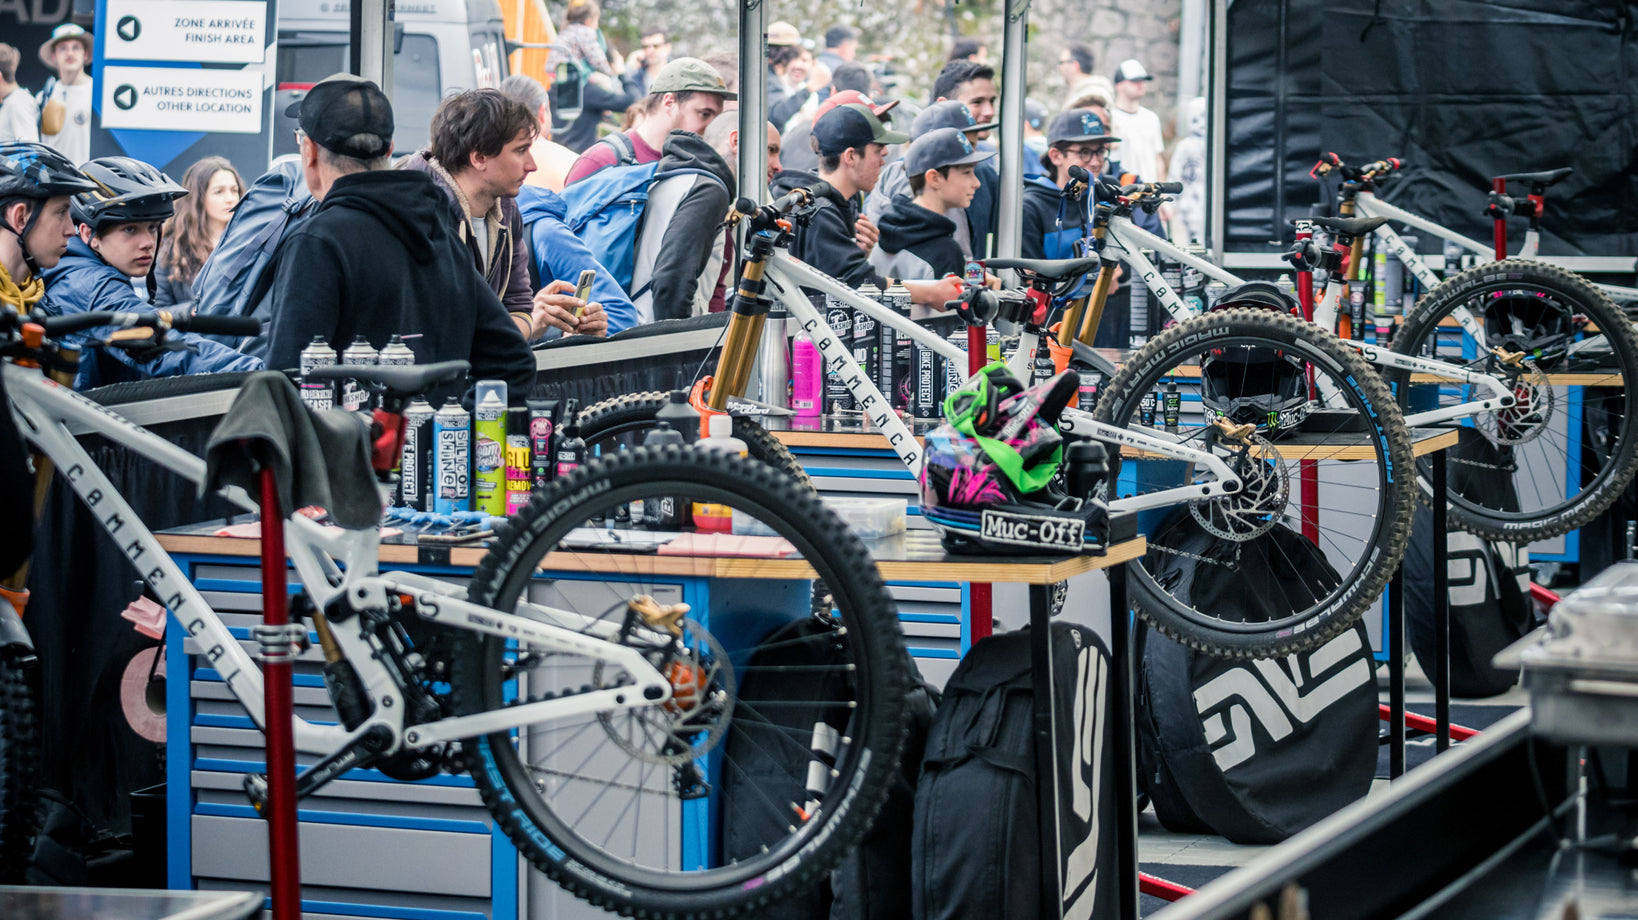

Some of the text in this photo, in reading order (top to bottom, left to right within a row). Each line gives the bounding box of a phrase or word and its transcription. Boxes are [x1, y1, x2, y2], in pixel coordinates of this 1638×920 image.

[174, 17, 256, 30] ZONE ARRIVÉE
[185, 32, 256, 45] FINISH AREA
[143, 86, 253, 99] AUTRES DIRECTIONS
[157, 101, 252, 114] OTHER LOCATION
[1418, 272, 1507, 325] SCHWALBE
[804, 318, 918, 467] COMMENCA
[921, 369, 931, 404] PROTECT
[507, 450, 531, 470] GLU
[404, 453, 415, 495] PROTECT
[986, 515, 1083, 547] Muc-Off
